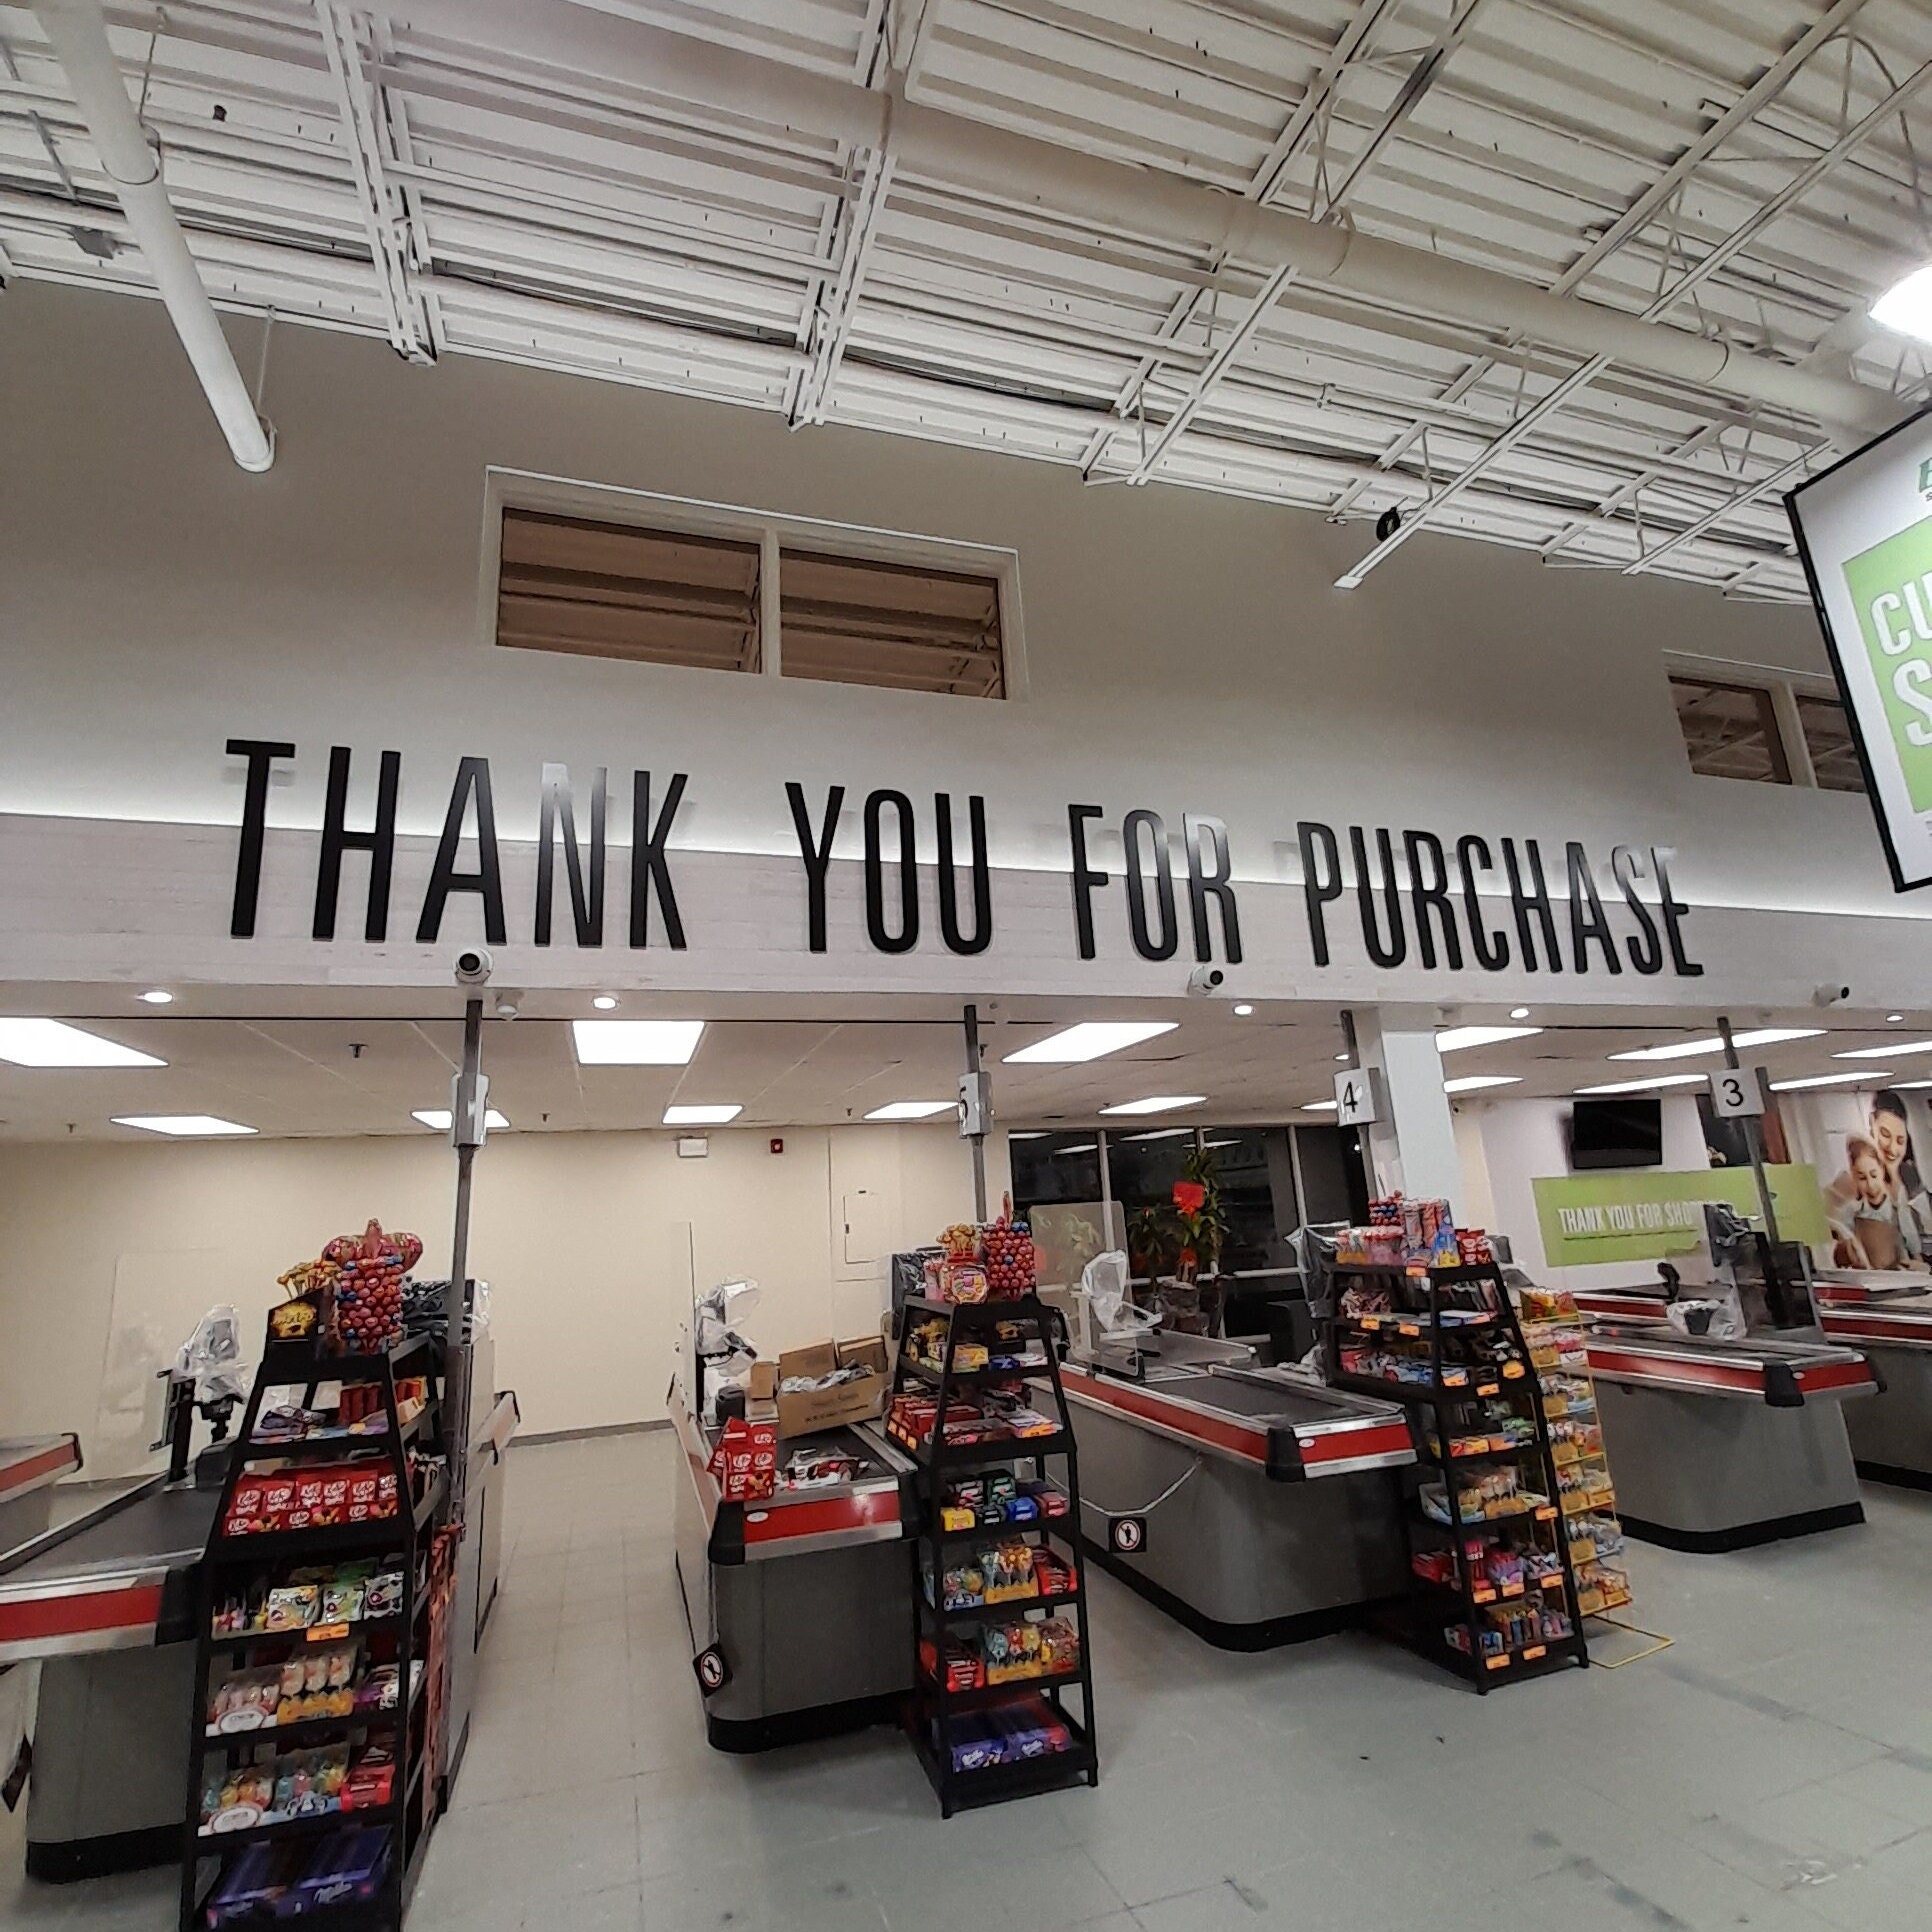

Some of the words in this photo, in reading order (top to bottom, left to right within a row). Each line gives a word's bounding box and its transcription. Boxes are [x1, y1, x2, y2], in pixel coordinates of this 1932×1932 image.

[226, 739, 687, 950] THANK
[784, 782, 992, 955] YOU
[1067, 803, 1243, 964] FOR
[1297, 821, 1704, 977] PURCHASE
[1343, 1081, 1358, 1113] 4
[1722, 1078, 1744, 1107] 3
[1558, 1207, 1605, 1233] THANK
[1606, 1205, 1635, 1230] YOU
[1636, 1203, 1664, 1228] FOR
